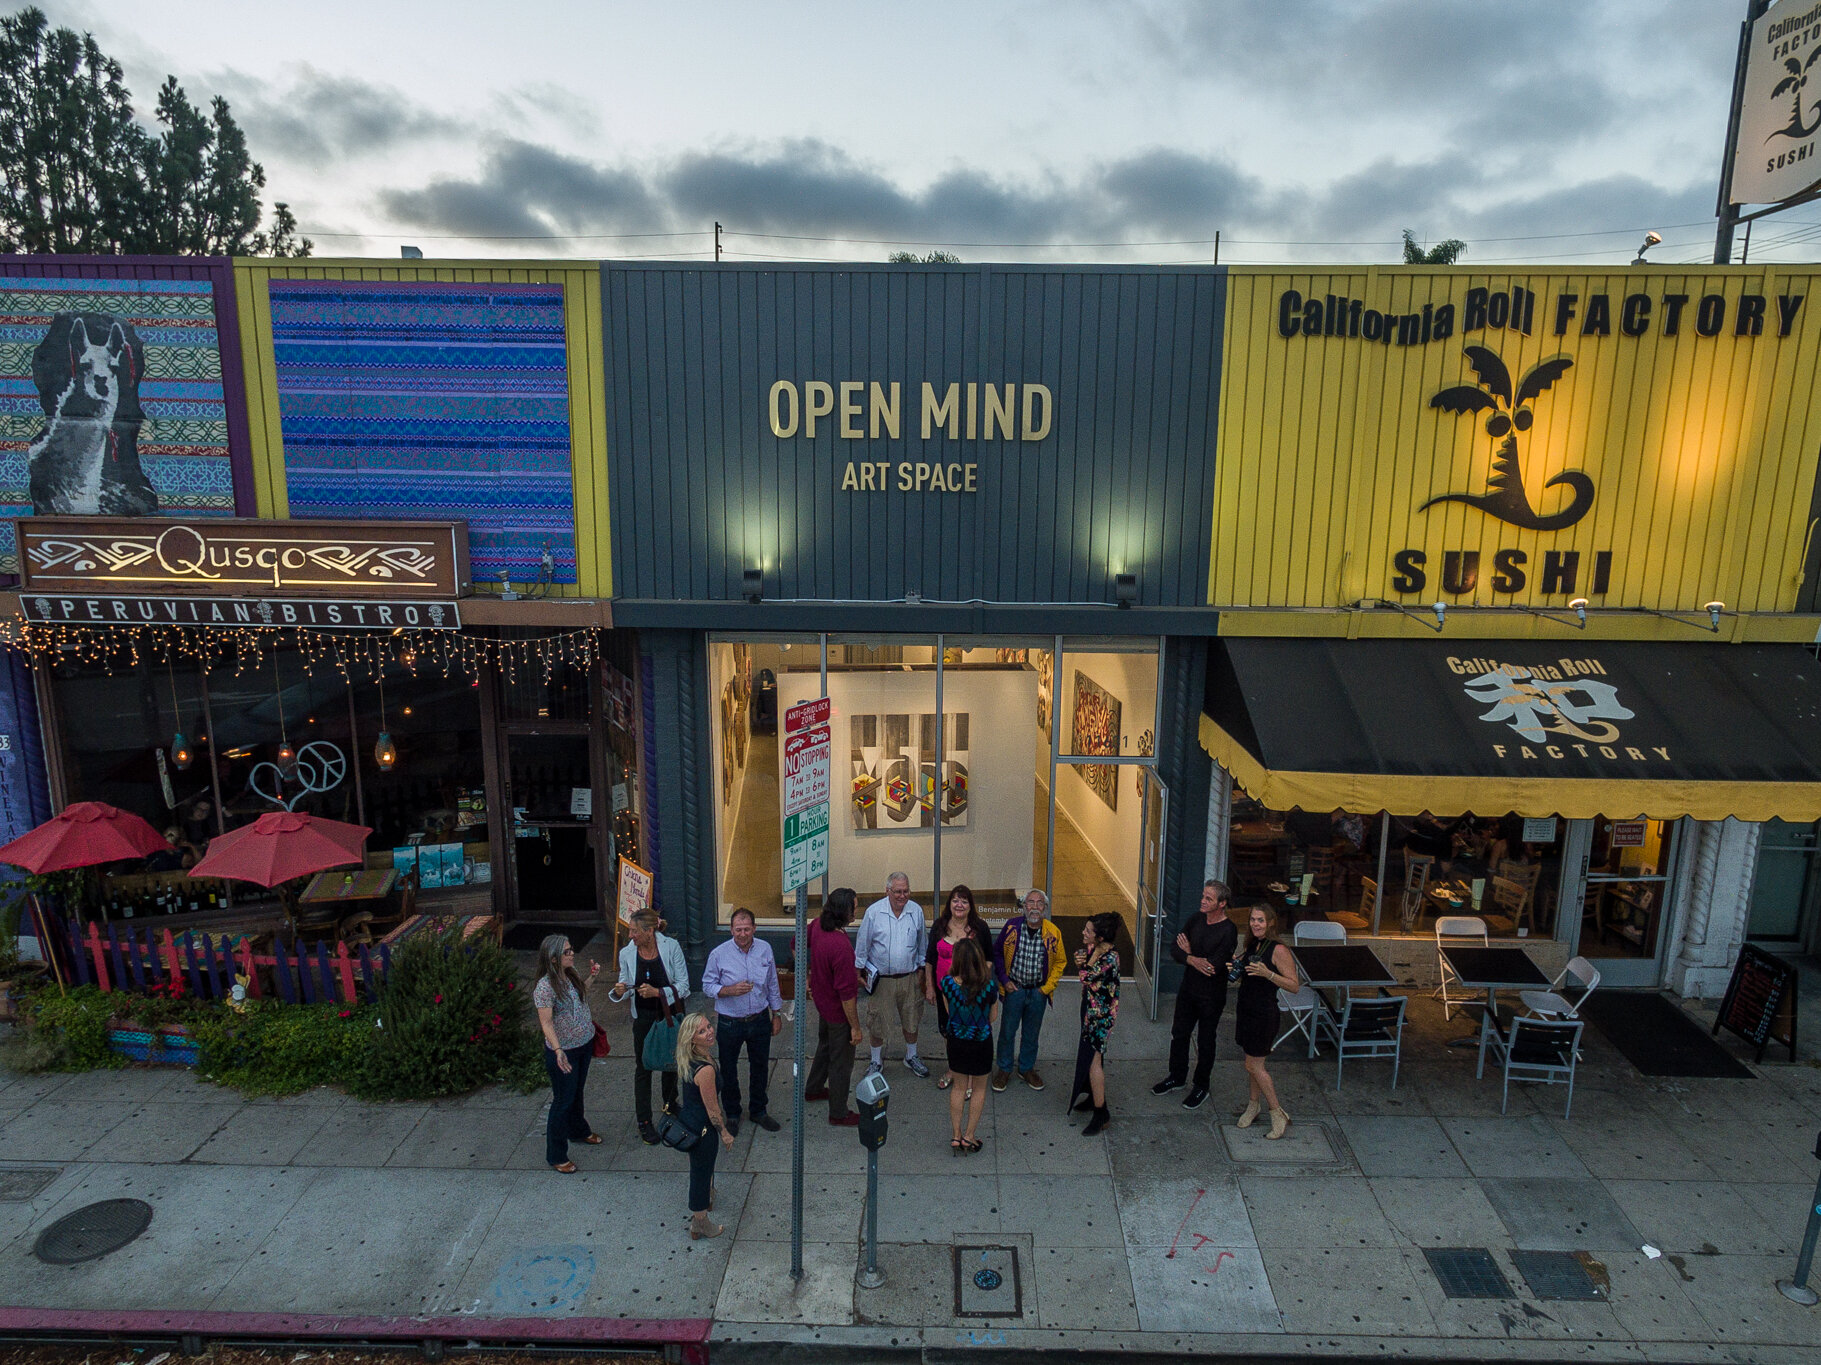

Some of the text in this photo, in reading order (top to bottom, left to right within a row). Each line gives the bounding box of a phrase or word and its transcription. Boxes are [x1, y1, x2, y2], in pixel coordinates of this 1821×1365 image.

[1773, 24, 1821, 61] FACTO
[1766, 142, 1815, 173] SUSHI
[1278, 285, 1805, 346] California Roll FACTORY
[768, 380, 1052, 441] OPEN MIND
[841, 462, 977, 492] ART SPACE
[156, 526, 306, 588] Qusqo
[1392, 549, 1613, 594] SUSHI
[61, 600, 419, 625] PERUVIAN BISTRO
[1446, 656, 1608, 680] California Roll
[787, 701, 829, 720] ANTI-GRIDLOCK
[801, 713, 816, 724] ZONE
[785, 745, 829, 776] NO STOPPING
[1492, 744, 1671, 760] FACTORY
[792, 776, 804, 787] 7AM
[812, 768, 825, 779] 9AM
[790, 788, 804, 800] 4PM
[812, 781, 825, 792] 6PM
[789, 818, 794, 837] 1
[800, 811, 828, 835] PARKING
[807, 806, 821, 818] HOUR
[811, 839, 825, 851] 8AM
[811, 860, 824, 872] 8PM
[978, 905, 1012, 915] Benjamin
